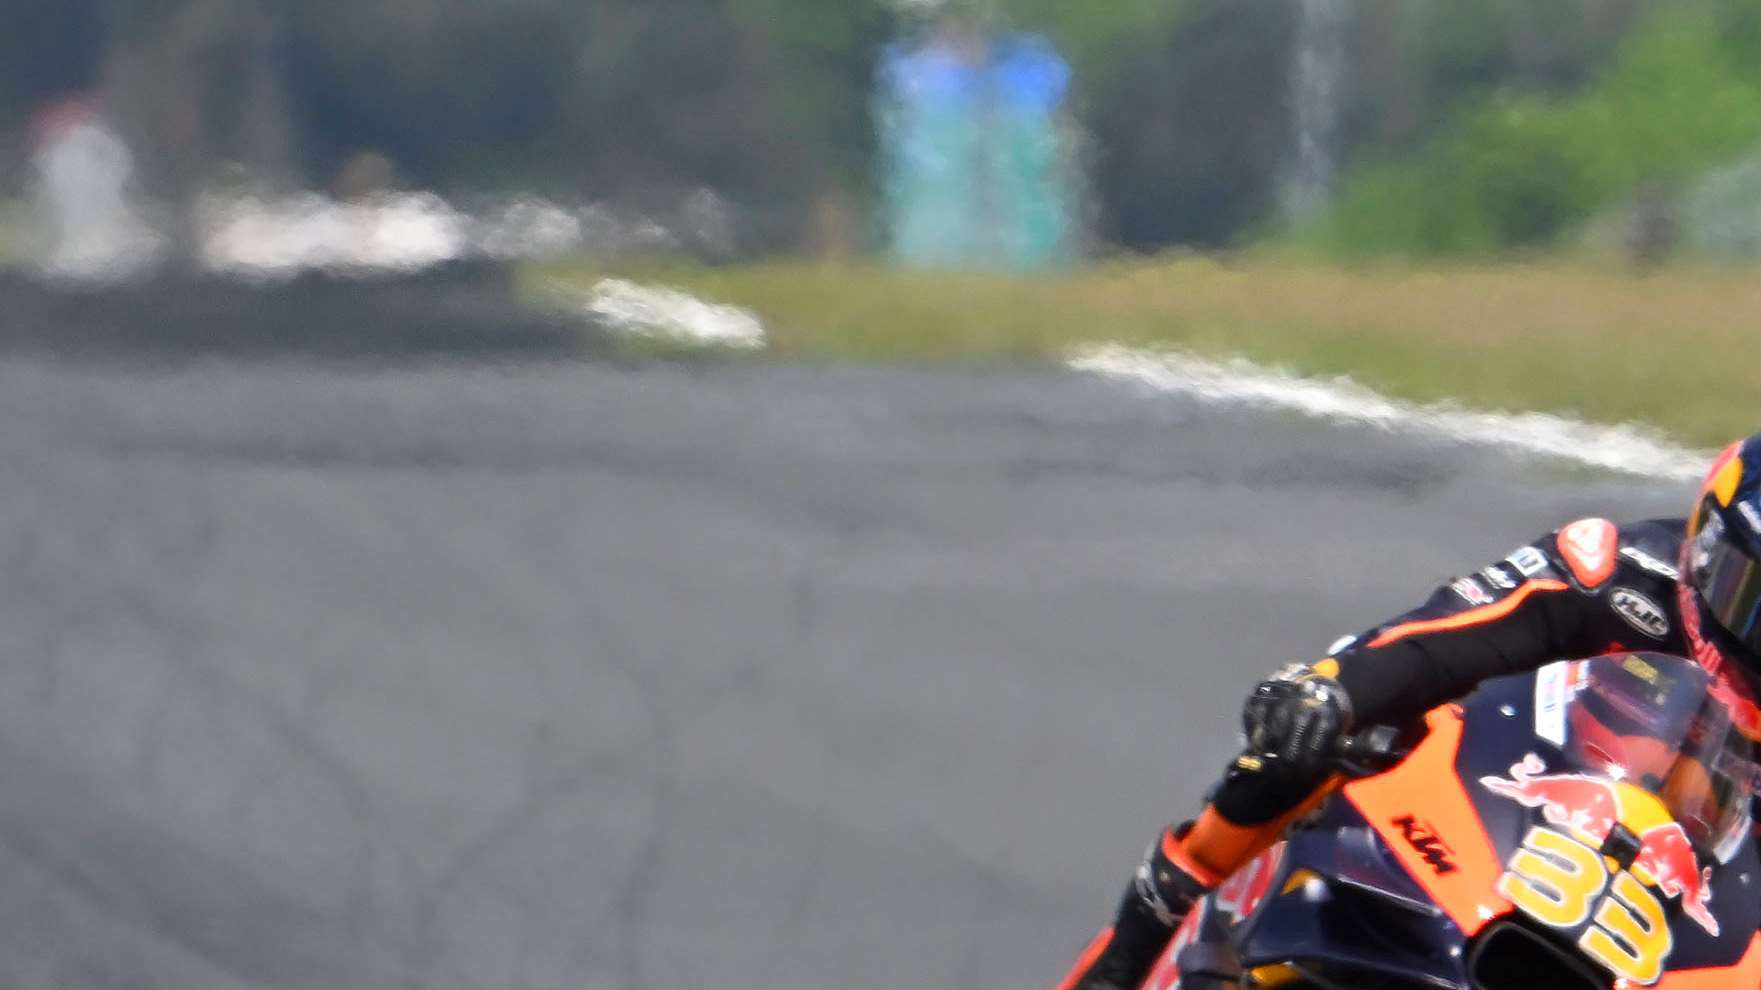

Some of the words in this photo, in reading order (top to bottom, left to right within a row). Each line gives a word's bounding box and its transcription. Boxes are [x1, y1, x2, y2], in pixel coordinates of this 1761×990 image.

[1616, 593, 1668, 635] HJC
[1391, 814, 1459, 876] KTM
[1498, 825, 1673, 986] 33
